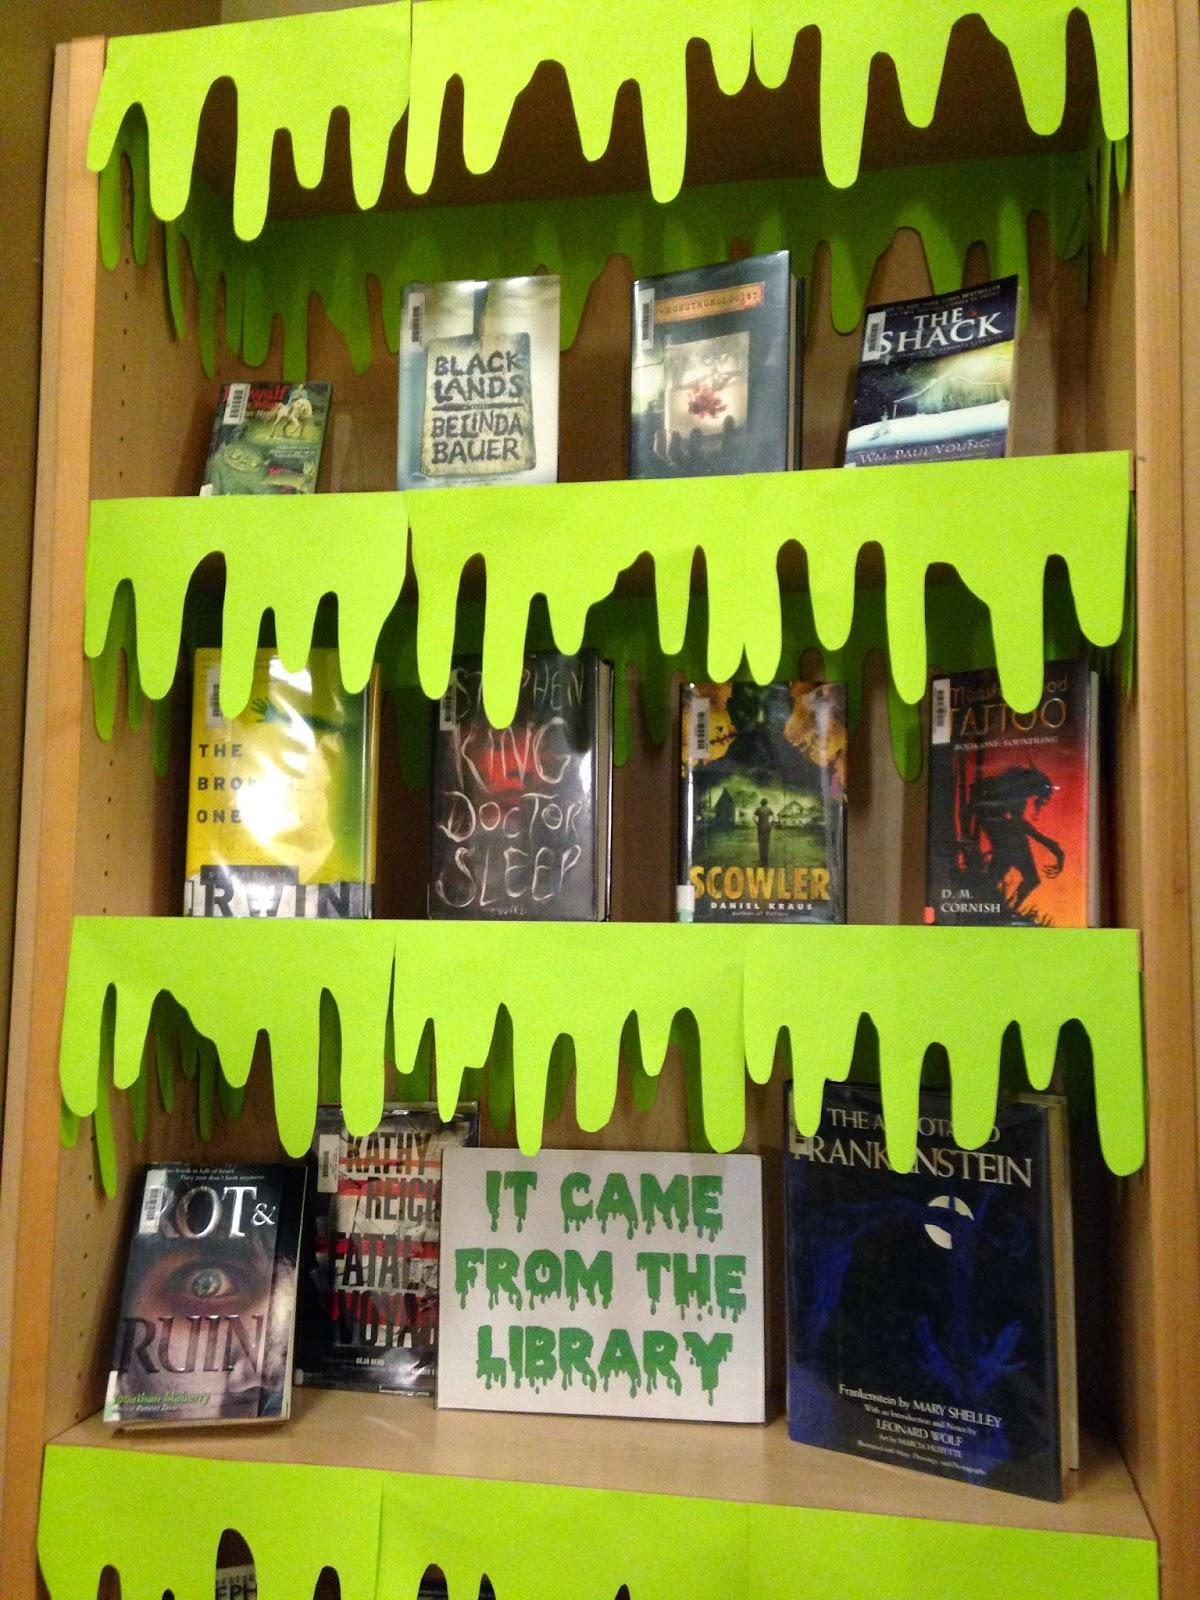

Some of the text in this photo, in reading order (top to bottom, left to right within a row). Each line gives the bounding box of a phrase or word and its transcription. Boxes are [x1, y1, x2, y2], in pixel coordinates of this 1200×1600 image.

[880, 311, 1003, 355] SHACK
[914, 307, 964, 331] THE
[434, 350, 524, 376] BLACK
[433, 374, 524, 403] LANDS
[431, 410, 524, 440] BELINDA
[431, 437, 521, 465] BAUER
[935, 438, 991, 454] YOUNG
[198, 743, 242, 758] THE
[453, 716, 571, 794] KING
[196, 809, 242, 824] ONE
[438, 789, 584, 844] DOCTOR
[434, 844, 582, 908] SLEEP
[688, 865, 831, 901] SCOWLER
[710, 901, 813, 911] DANIEL KRAUS
[940, 902, 1001, 914] CORNISH
[941, 888, 973, 900] D. M.
[826, 1107, 870, 1130] THE
[346, 1131, 432, 1176] KATHY
[793, 1131, 1033, 1188] FRANKNSTEIN
[251, 1202, 276, 1226] &
[365, 1176, 442, 1223] REICH
[485, 1170, 724, 1243] IT CAME
[454, 1247, 747, 1323] FROM THE
[119, 1314, 267, 1376] RUIN
[475, 1324, 734, 1406] LIBRARY
[838, 1383, 1003, 1429] Frankenstein by MARY SHELLEY
[875, 1417, 964, 1448] LEONARD WOLF
